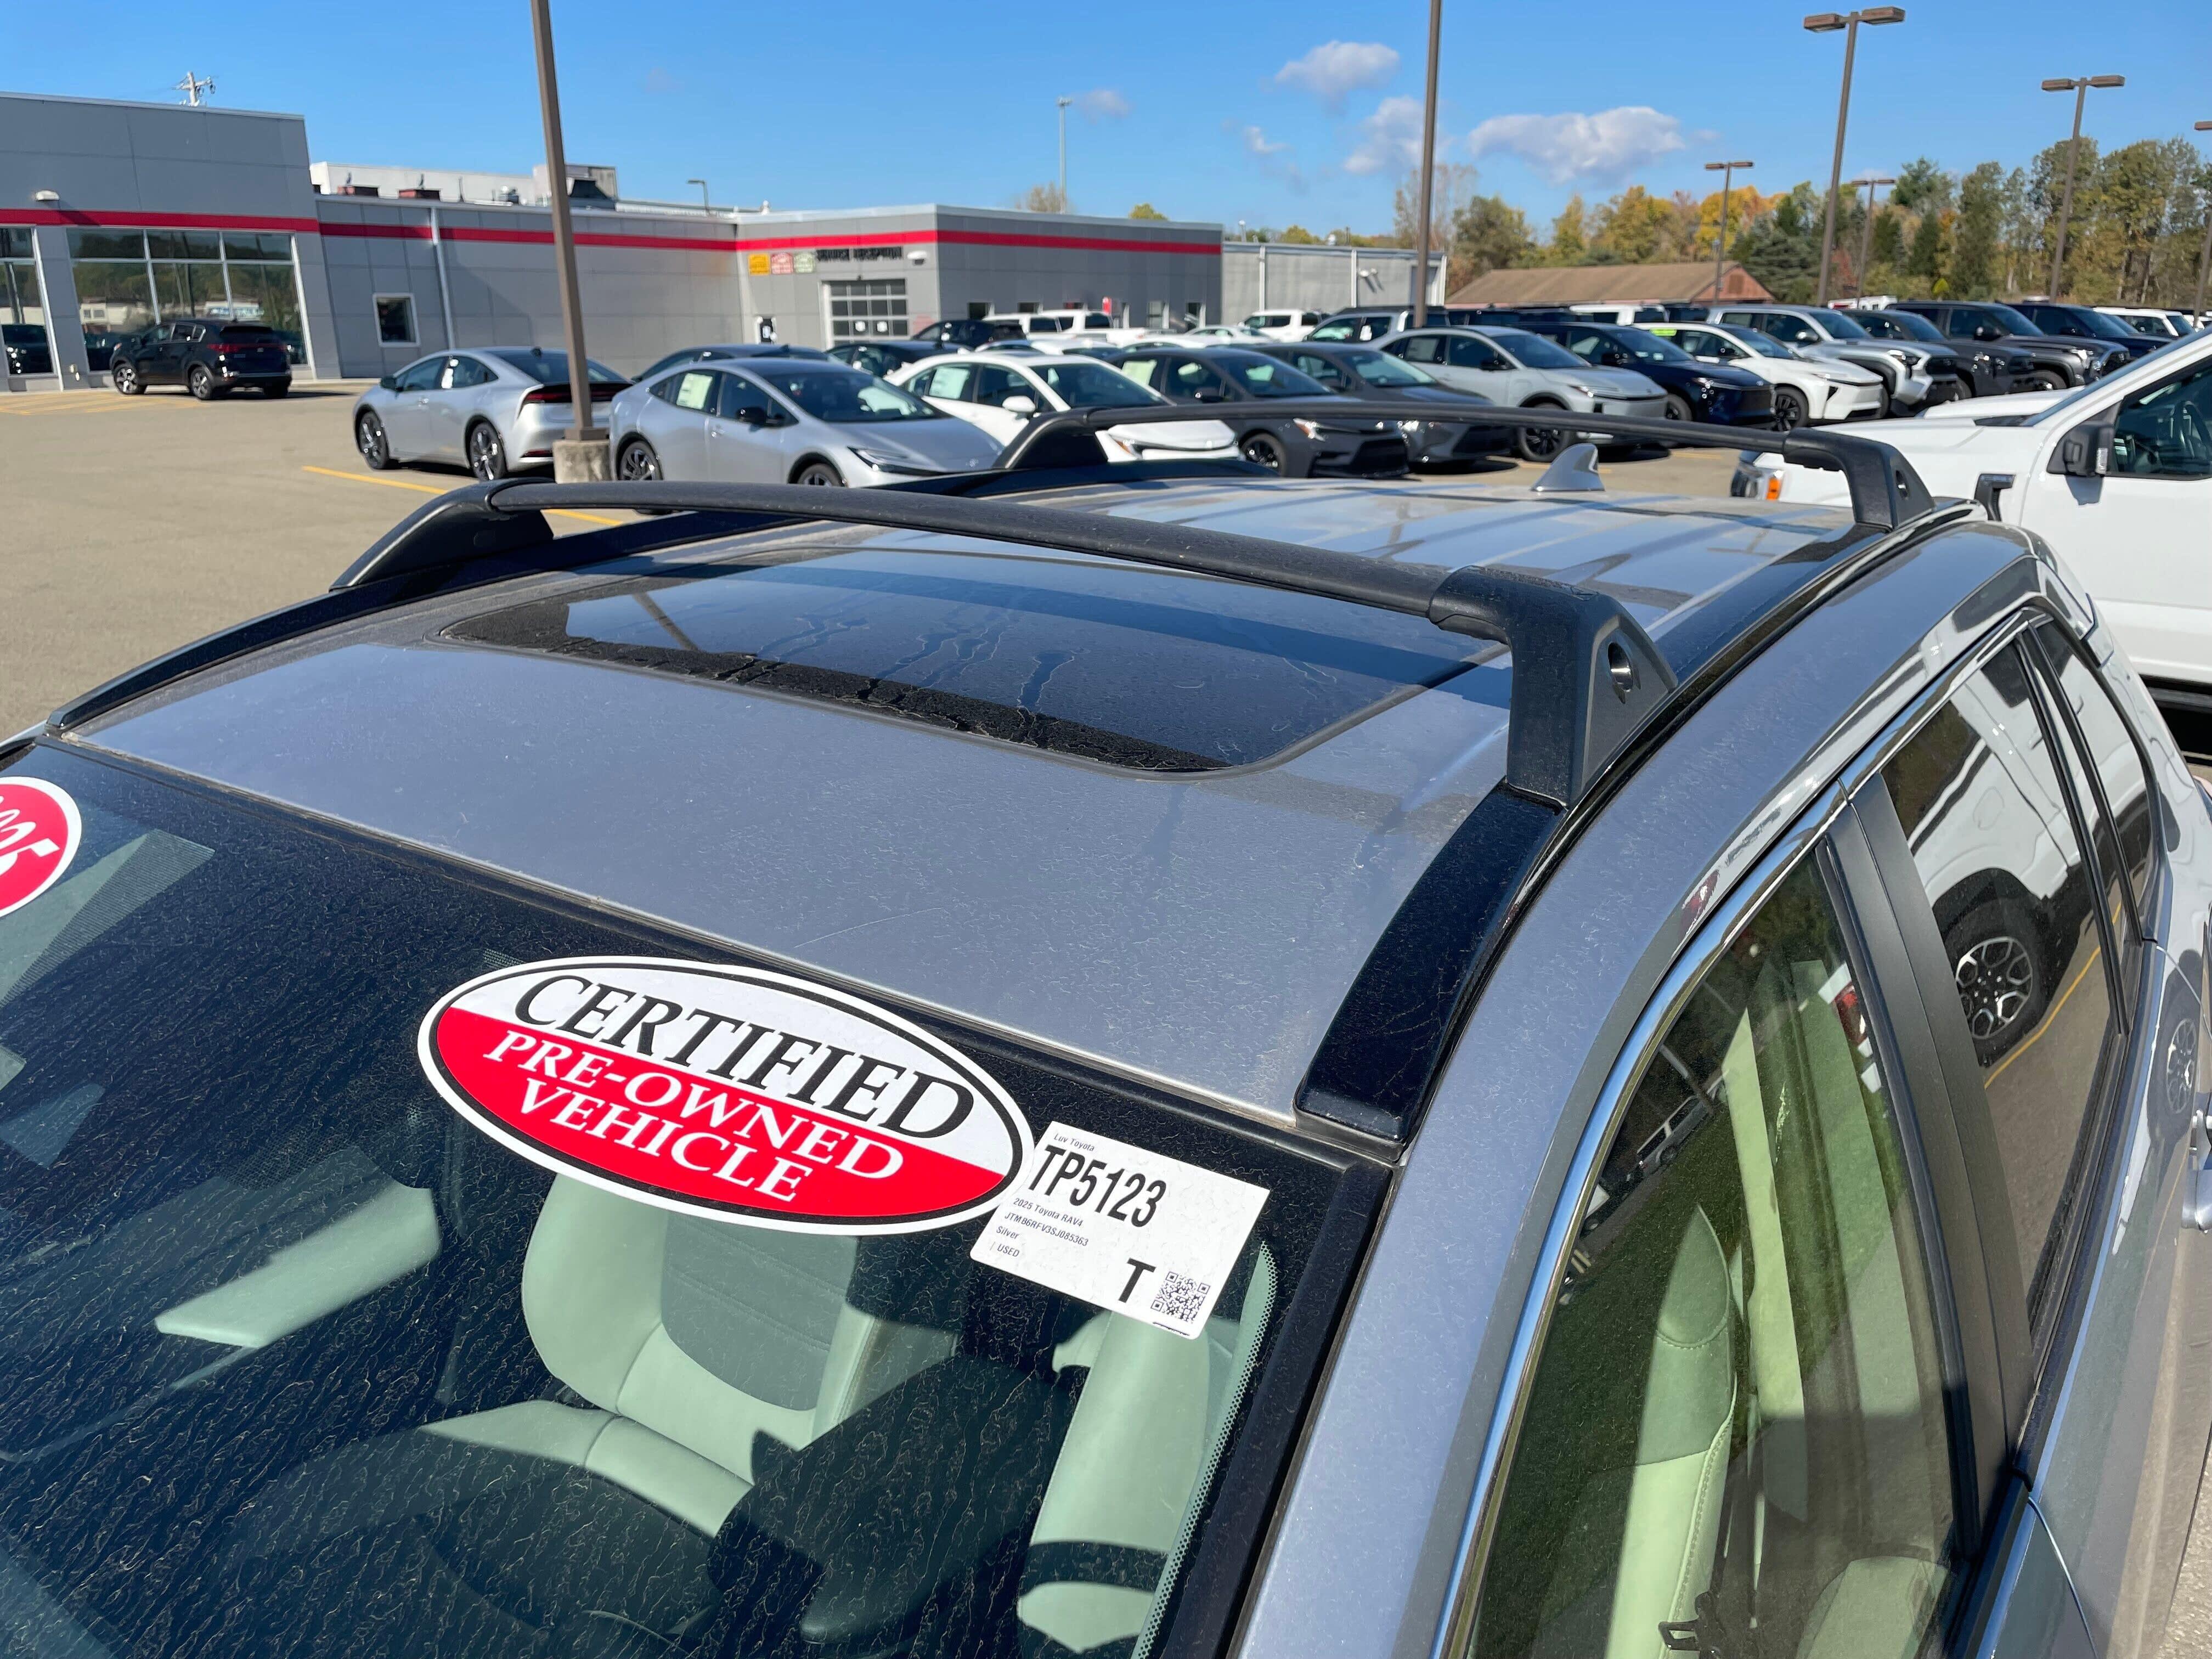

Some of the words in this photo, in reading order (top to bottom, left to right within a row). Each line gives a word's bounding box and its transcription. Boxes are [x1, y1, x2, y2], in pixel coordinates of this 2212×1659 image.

[515, 975, 974, 1138] CERTIFIED
[482, 1030, 904, 1180] PRE-OWNED
[520, 1077, 813, 1203] VEHICLE
[1054, 1133, 1069, 1143] Luv
[1070, 1138, 1096, 1152] Toyota
[1028, 1144, 1167, 1228] TP5123
[996, 1226, 1020, 1240] Silver
[1013, 1198, 1034, 1210] 2025
[1034, 1204, 1060, 1219] Toyota
[1060, 1214, 1085, 1227] RAV4
[997, 1243, 1020, 1257] USED
[1118, 1257, 1156, 1304] T
